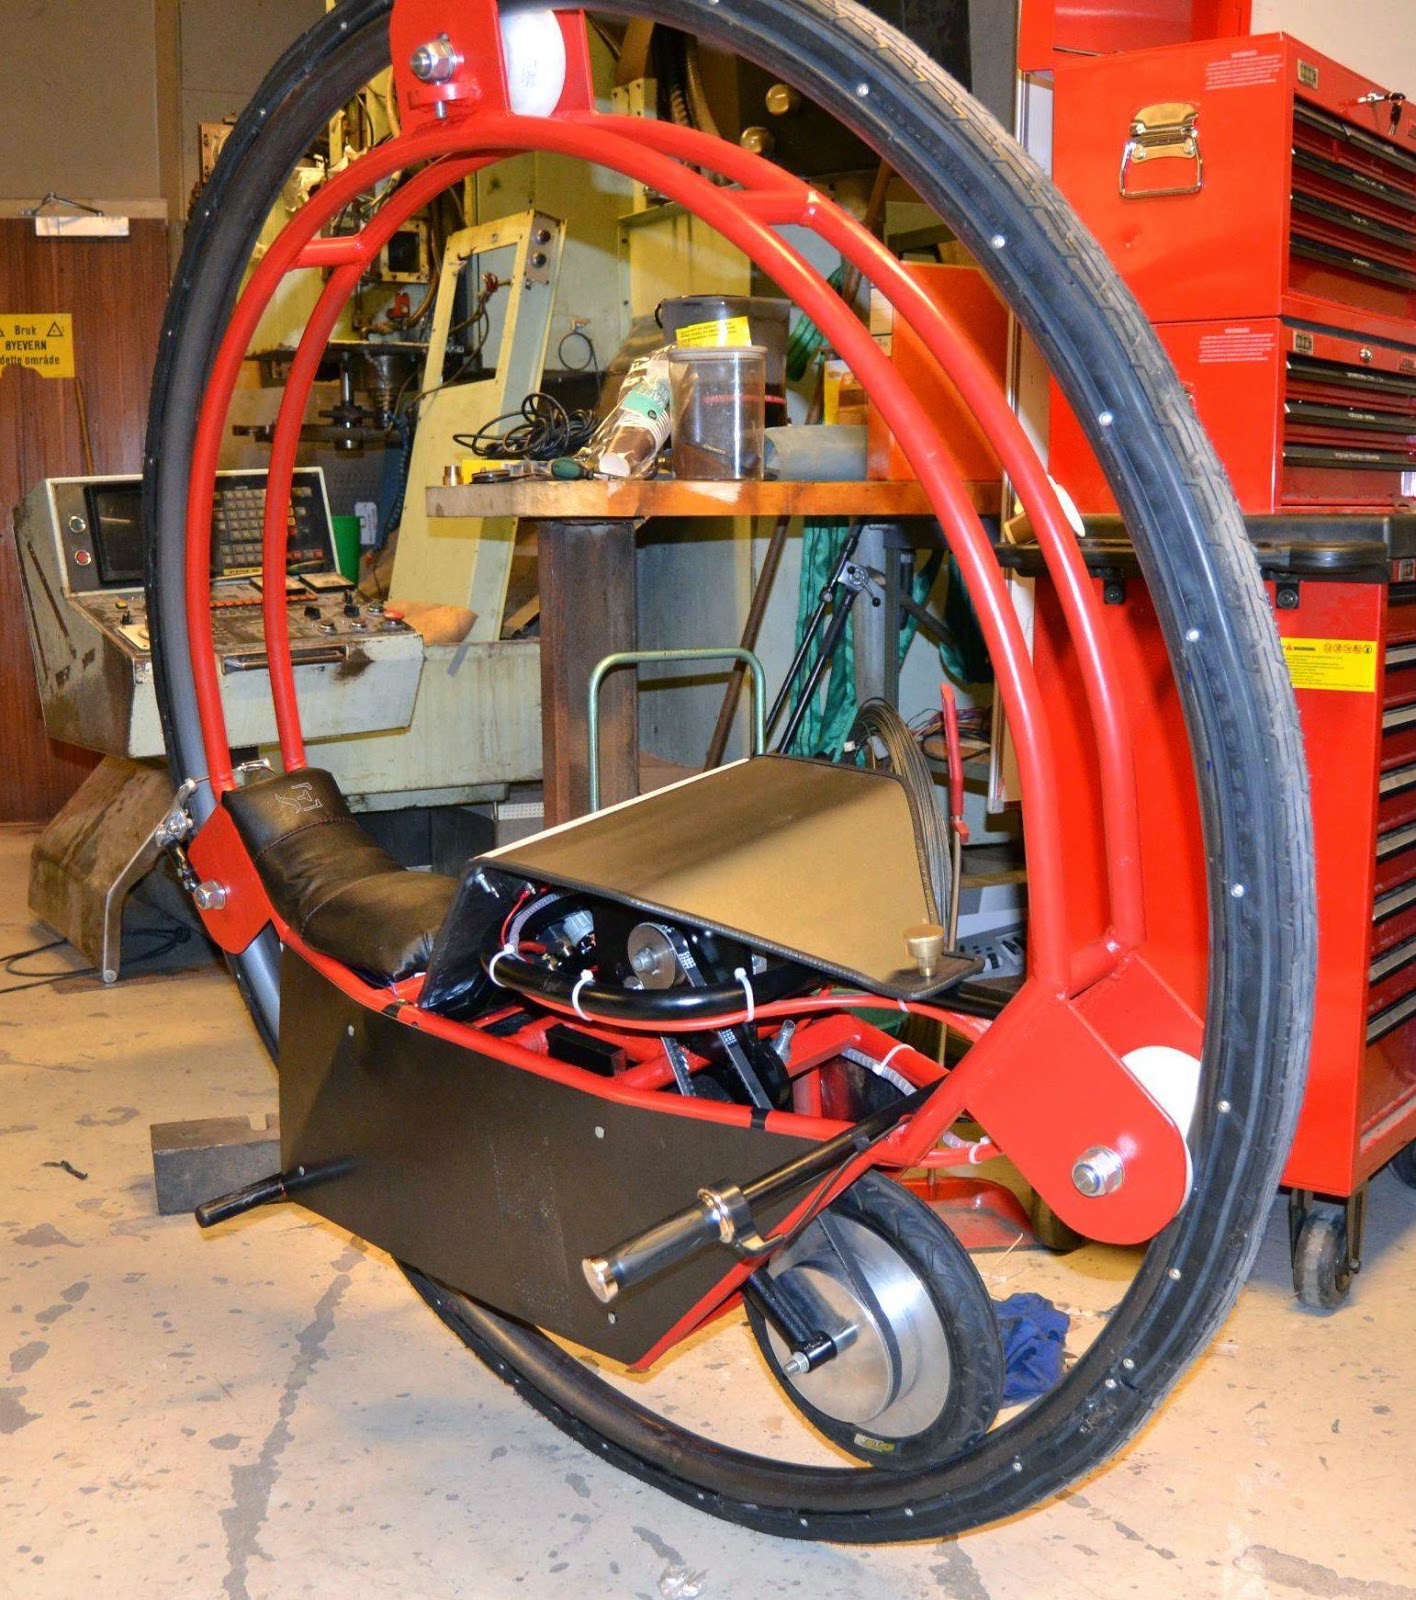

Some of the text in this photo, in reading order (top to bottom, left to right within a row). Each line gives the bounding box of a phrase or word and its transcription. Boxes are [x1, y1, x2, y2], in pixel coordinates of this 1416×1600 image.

[15, 325, 36, 335] Bruk
[0, 355, 60, 365] dette område
